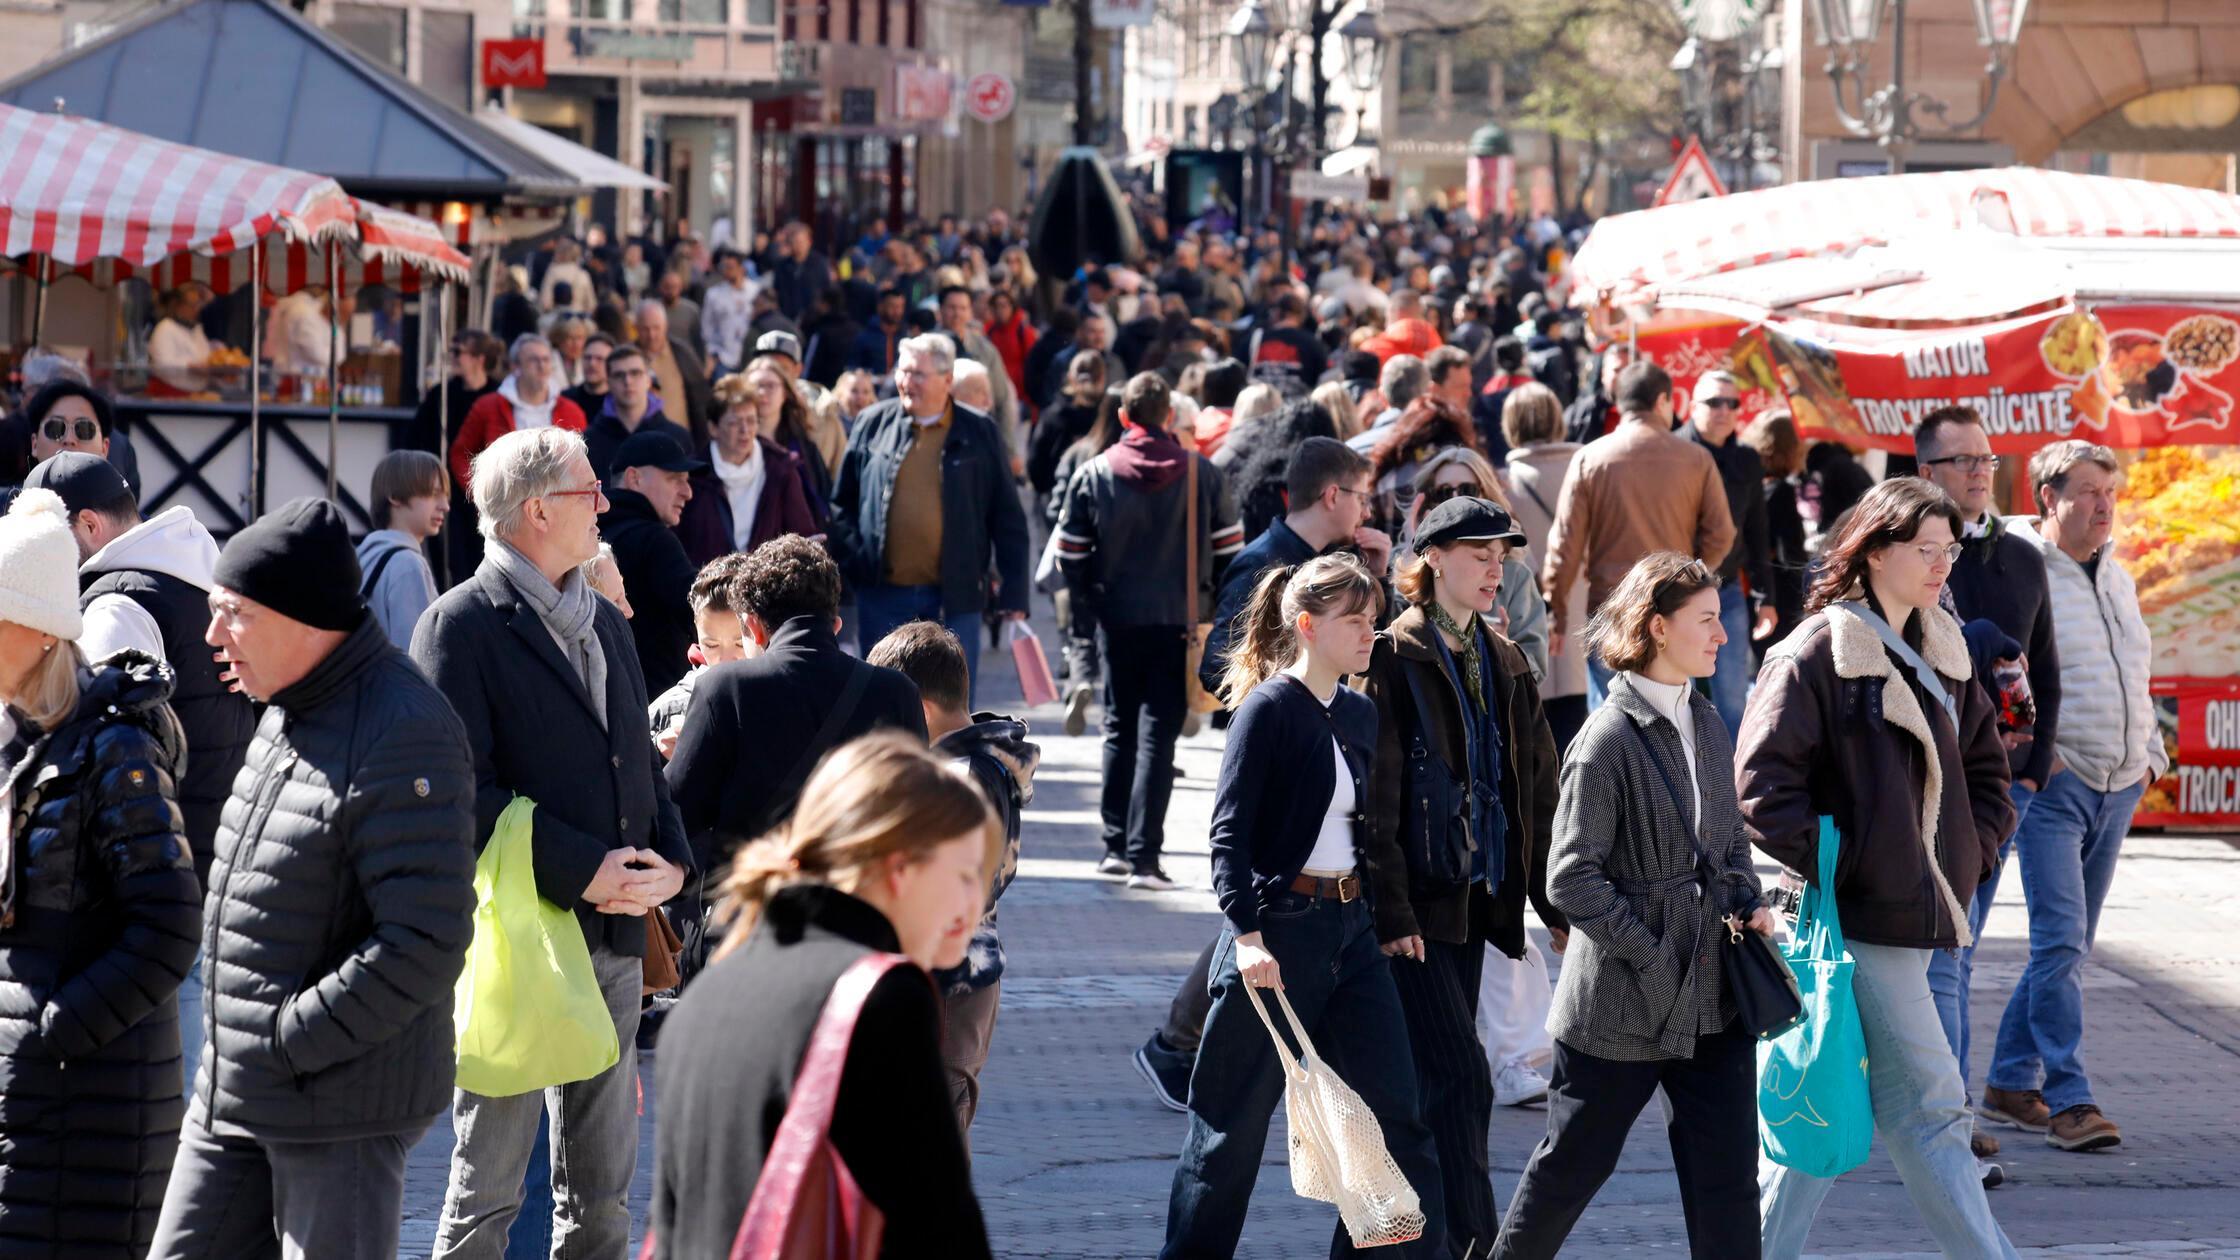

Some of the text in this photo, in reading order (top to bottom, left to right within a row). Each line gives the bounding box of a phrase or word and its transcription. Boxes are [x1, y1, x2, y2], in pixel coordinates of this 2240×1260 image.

[1903, 336, 1991, 379] NATUR
[1852, 386, 2074, 437] TROCK RÜCHTE
[2205, 699, 2240, 750] OH
